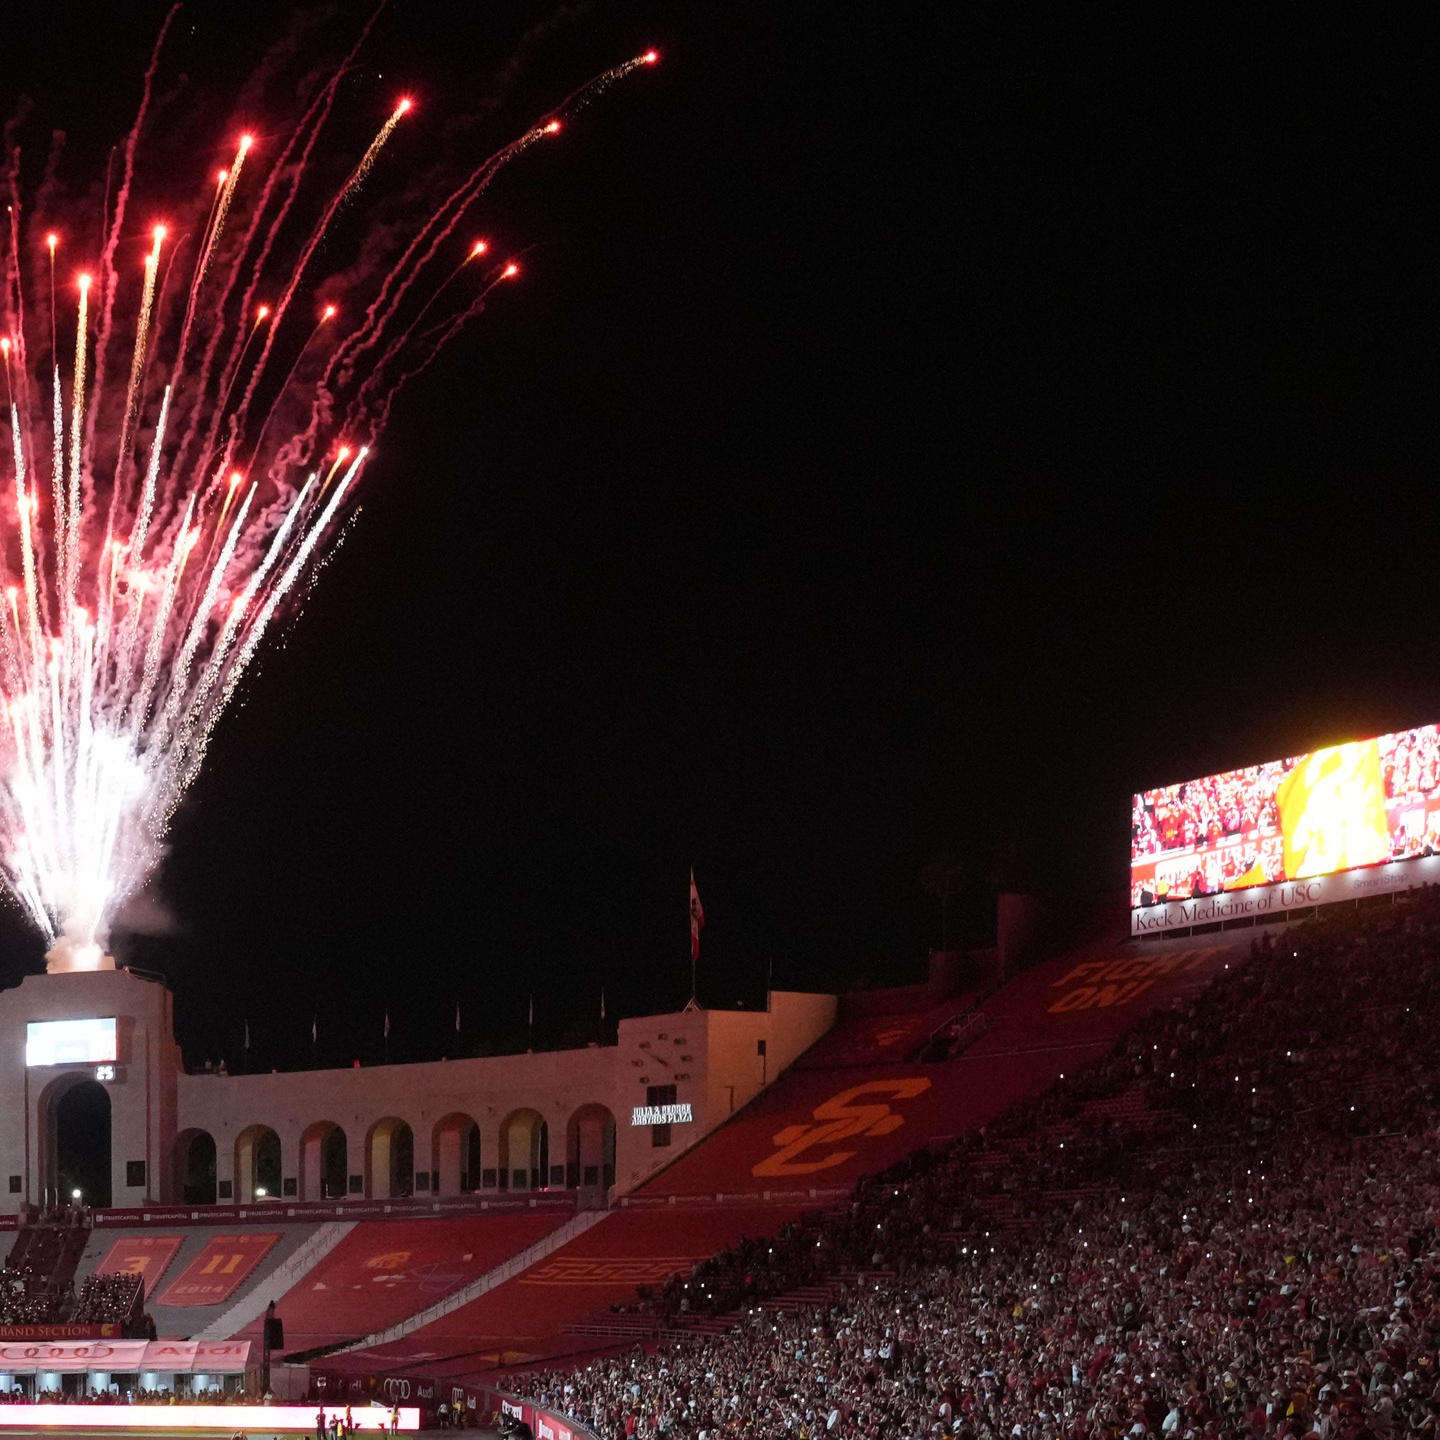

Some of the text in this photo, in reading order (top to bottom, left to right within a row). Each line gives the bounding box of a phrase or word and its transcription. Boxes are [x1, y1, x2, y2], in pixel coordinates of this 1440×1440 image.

[1135, 882, 1322, 932] Keck Medicine of USC
[1052, 946, 1224, 988] FIGHT
[1047, 980, 1155, 1014] ON!
[96, 1065, 114, 1081] 25
[120, 1256, 151, 1274] 3
[200, 1254, 245, 1274] 11
[175, 1285, 225, 1294] 2004
[0, 1326, 33, 1336] BAND
[39, 1326, 91, 1336] SECTION
[155, 1344, 244, 1356] Audi
[417, 1384, 435, 1398] Audi
